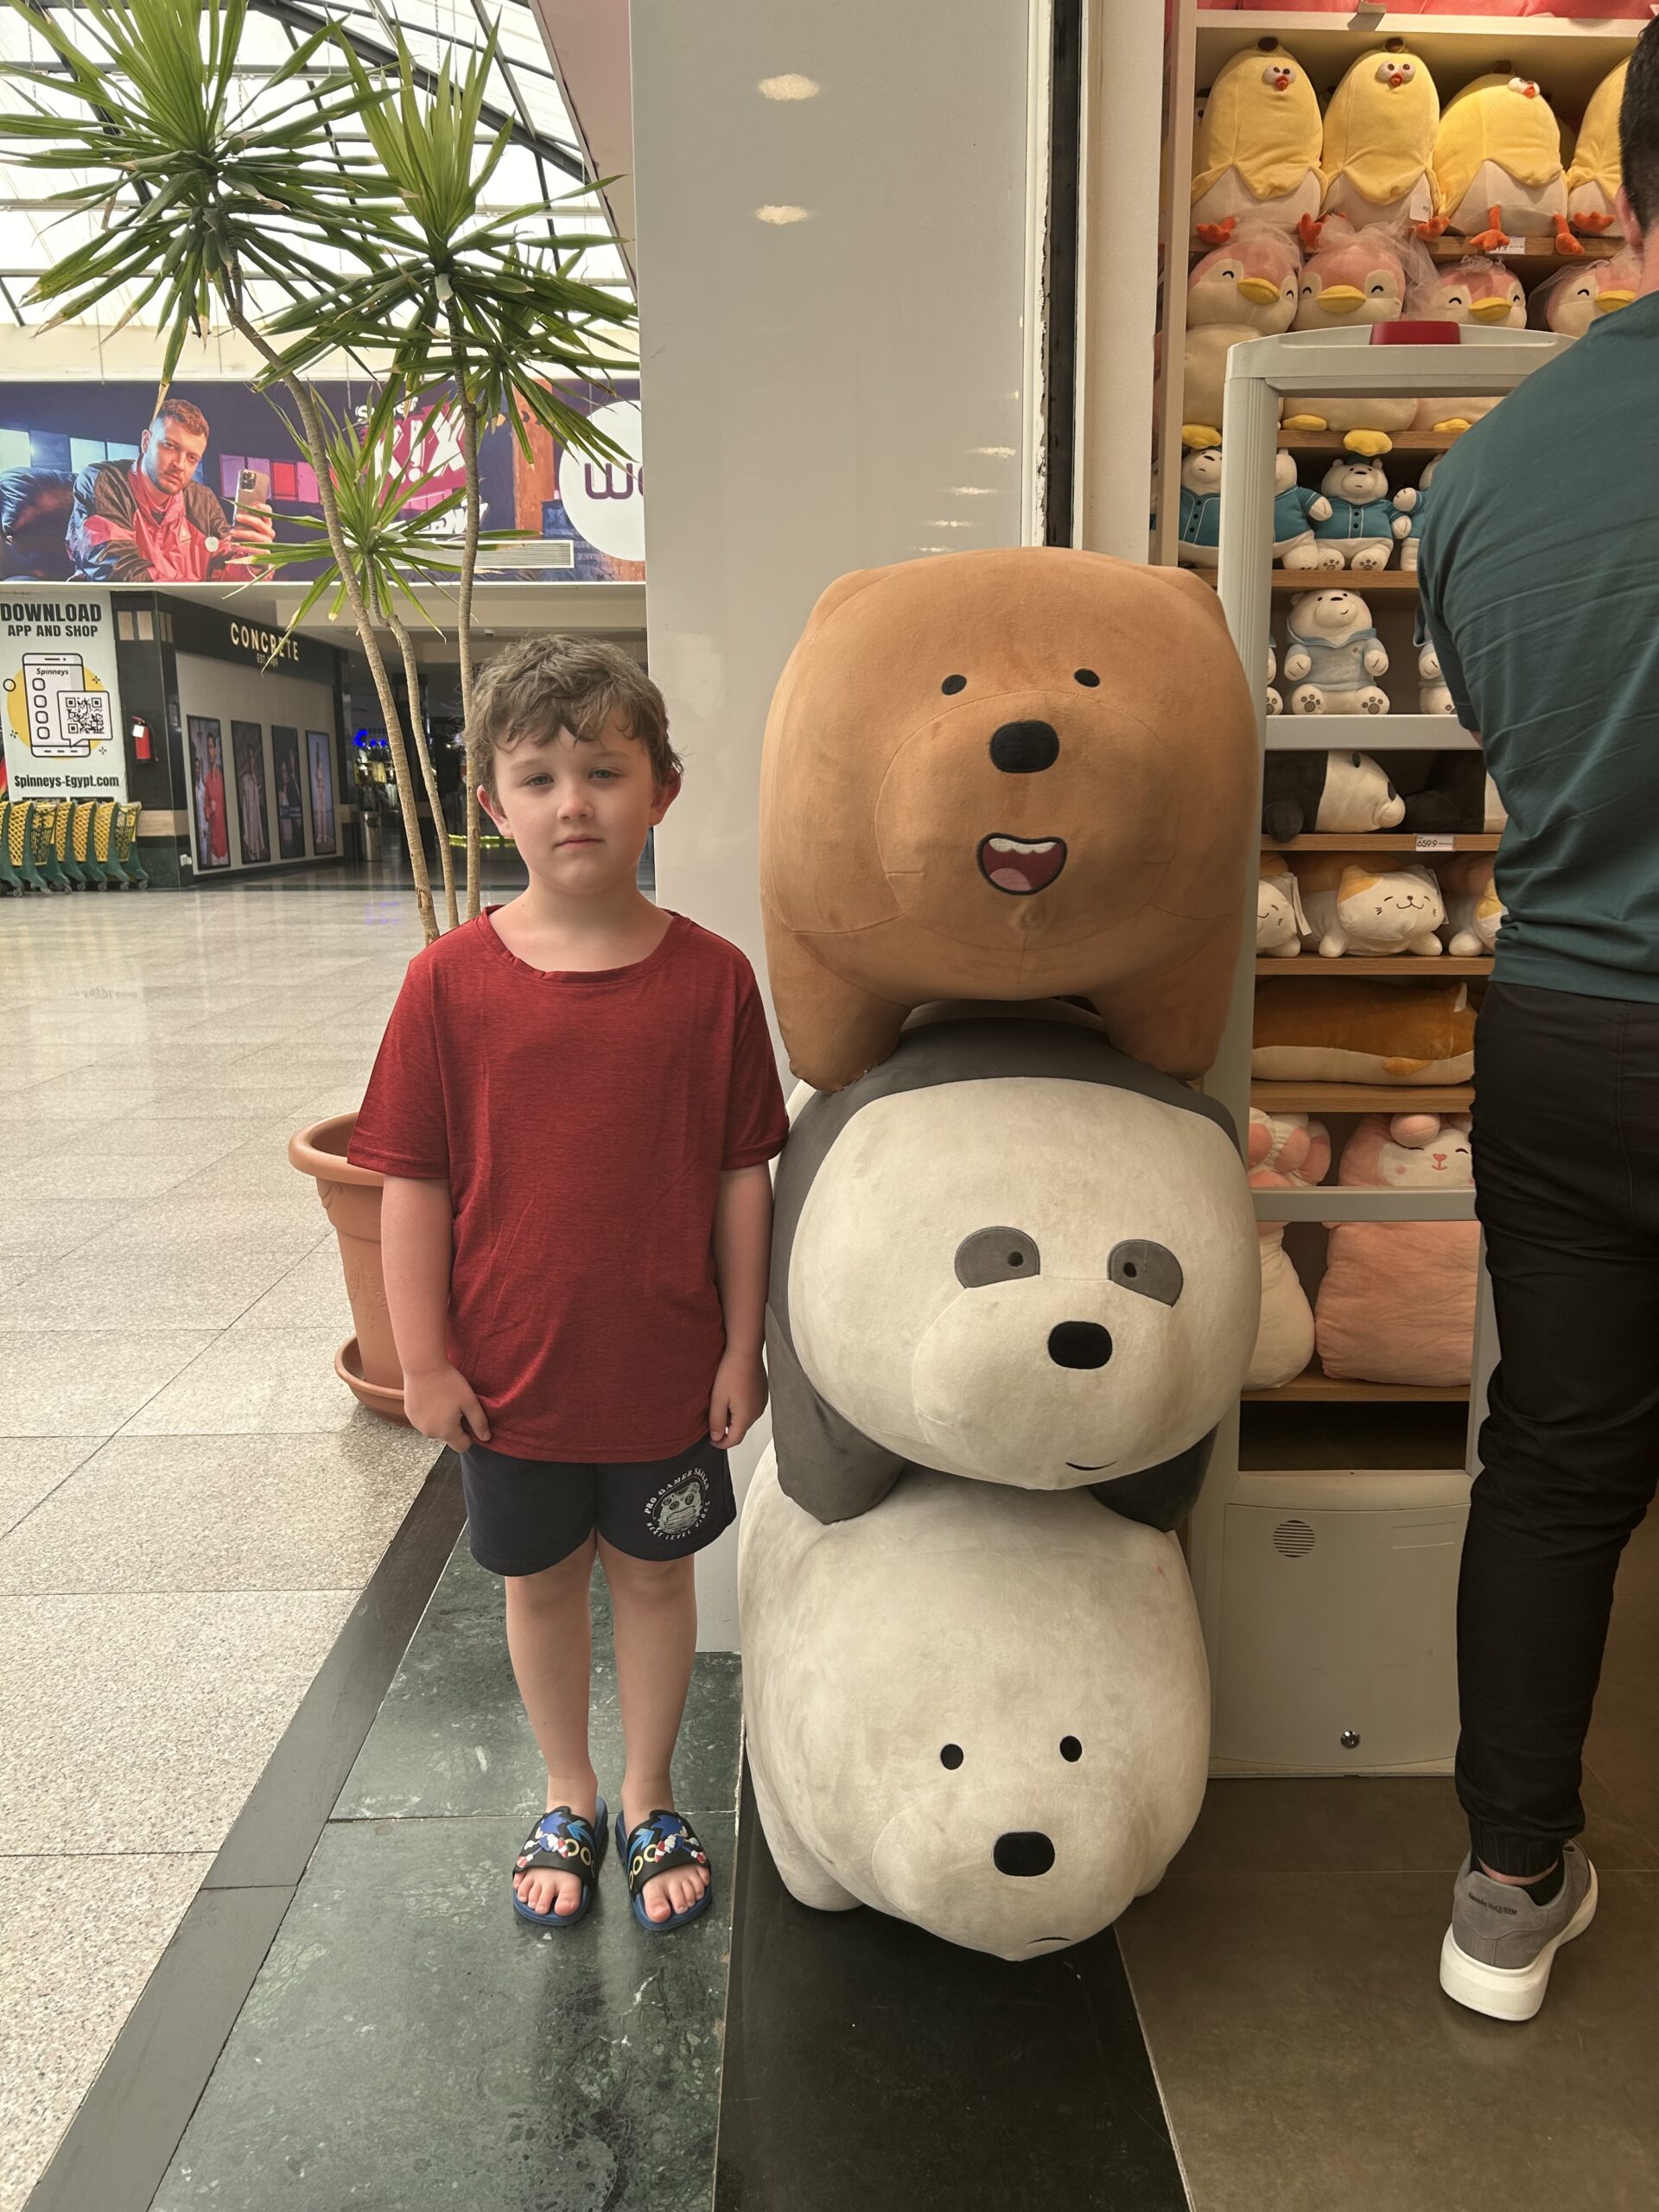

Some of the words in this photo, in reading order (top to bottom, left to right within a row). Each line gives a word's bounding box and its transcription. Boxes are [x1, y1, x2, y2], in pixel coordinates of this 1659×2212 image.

[354, 397, 419, 423] Ser
[584, 462, 643, 499] w
[0, 602, 102, 622] DOWNLOAD
[8, 625, 32, 637] APP
[36, 625, 61, 637] AND
[66, 625, 99, 637] SHOP
[36, 667, 69, 676] Spinneys
[15, 774, 119, 788] Spinneys-Egypt.com
[644, 1497, 658, 1515] PRO
[645, 1522, 664, 1537] NEXT
[664, 1529, 691, 1541] LEVEL
